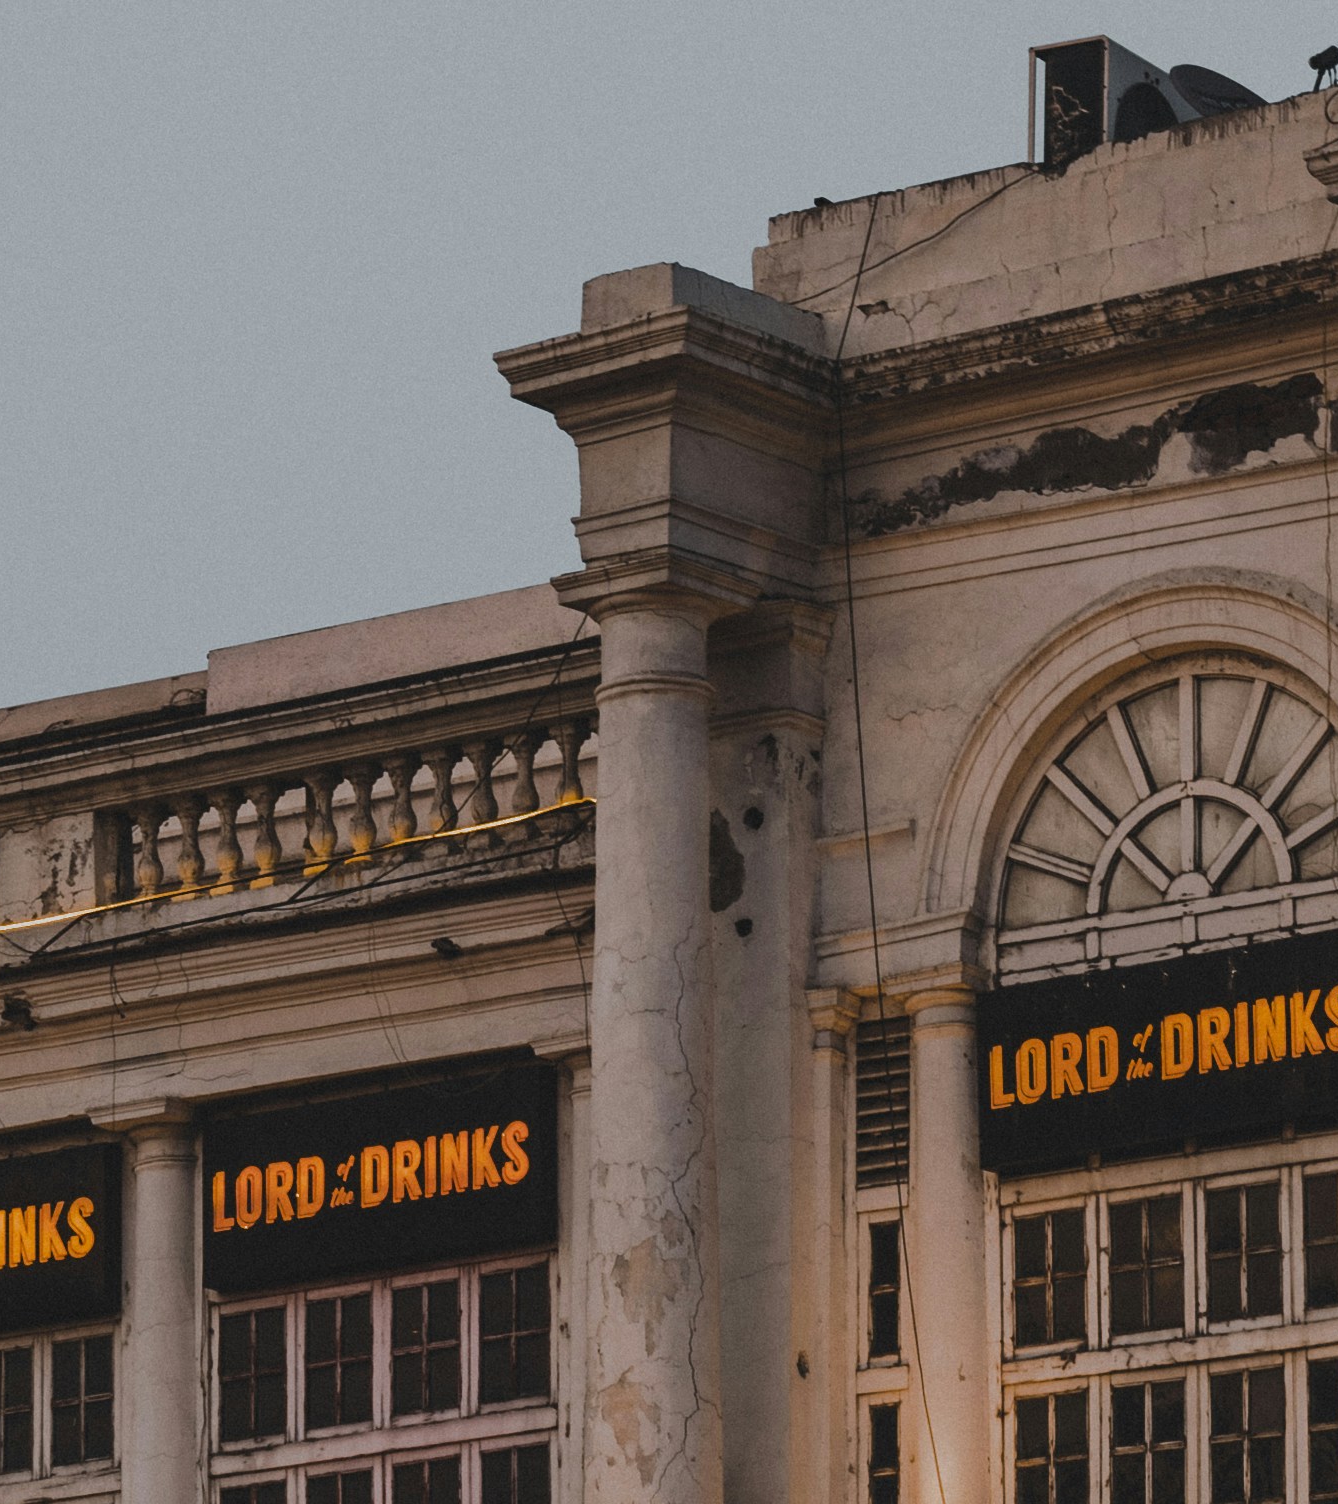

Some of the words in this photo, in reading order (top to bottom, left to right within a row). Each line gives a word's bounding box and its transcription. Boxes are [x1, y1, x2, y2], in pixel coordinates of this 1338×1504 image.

[1132, 1024, 1154, 1054] of
[989, 1026, 1120, 1110] LORD
[1125, 1057, 1154, 1081] the
[336, 1155, 356, 1183] of
[360, 1120, 530, 1209] DRINKS
[212, 1155, 326, 1233] LORD
[329, 1186, 355, 1209] the
